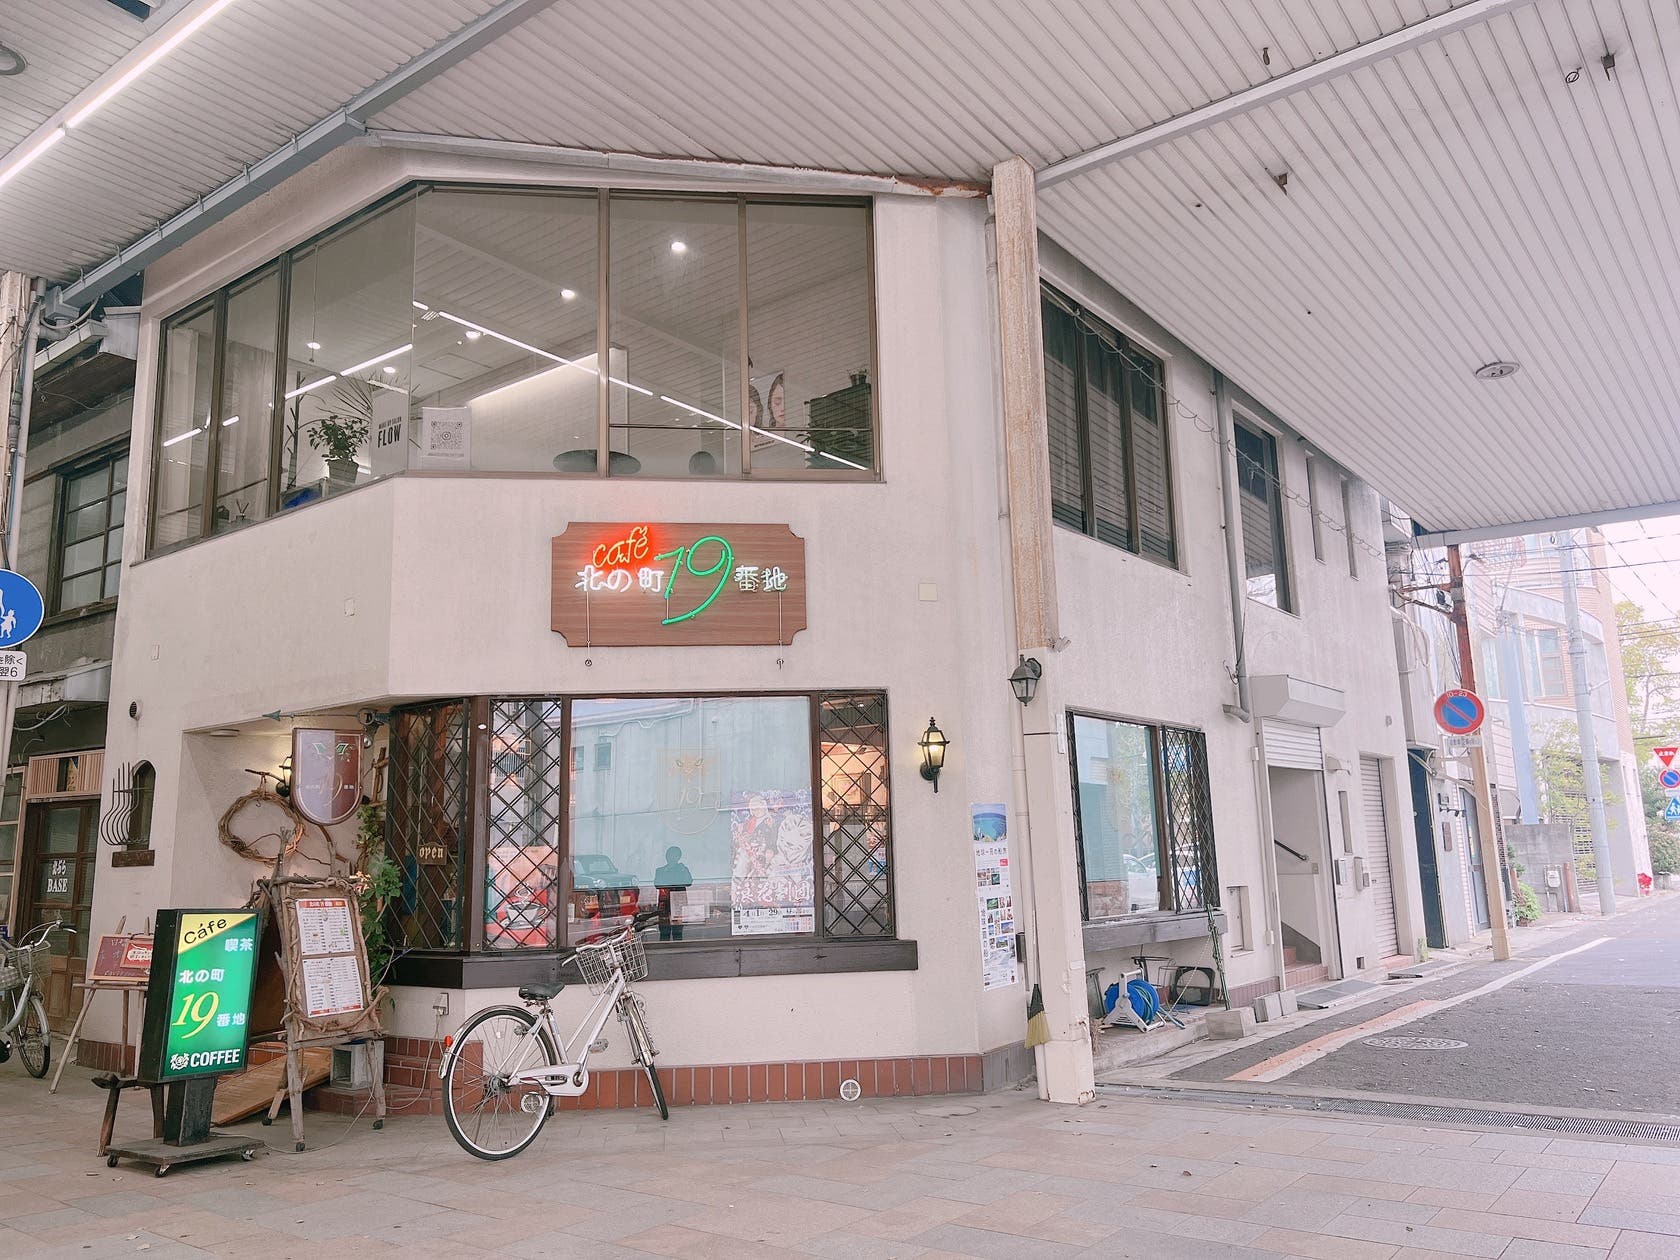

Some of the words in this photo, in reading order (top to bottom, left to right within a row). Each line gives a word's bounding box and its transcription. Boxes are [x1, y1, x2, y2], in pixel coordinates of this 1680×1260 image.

[378, 424, 402, 449] FLOW
[653, 535, 734, 625] 19
[0, 654, 24, 665] 除く
[419, 846, 444, 860] open
[47, 878, 68, 893] BASE
[224, 938, 254, 952] 喫茶
[178, 968, 225, 984] 北の町
[171, 991, 220, 1039] 19
[216, 1012, 246, 1027] 番地
[190, 1049, 241, 1068] COFFEE
